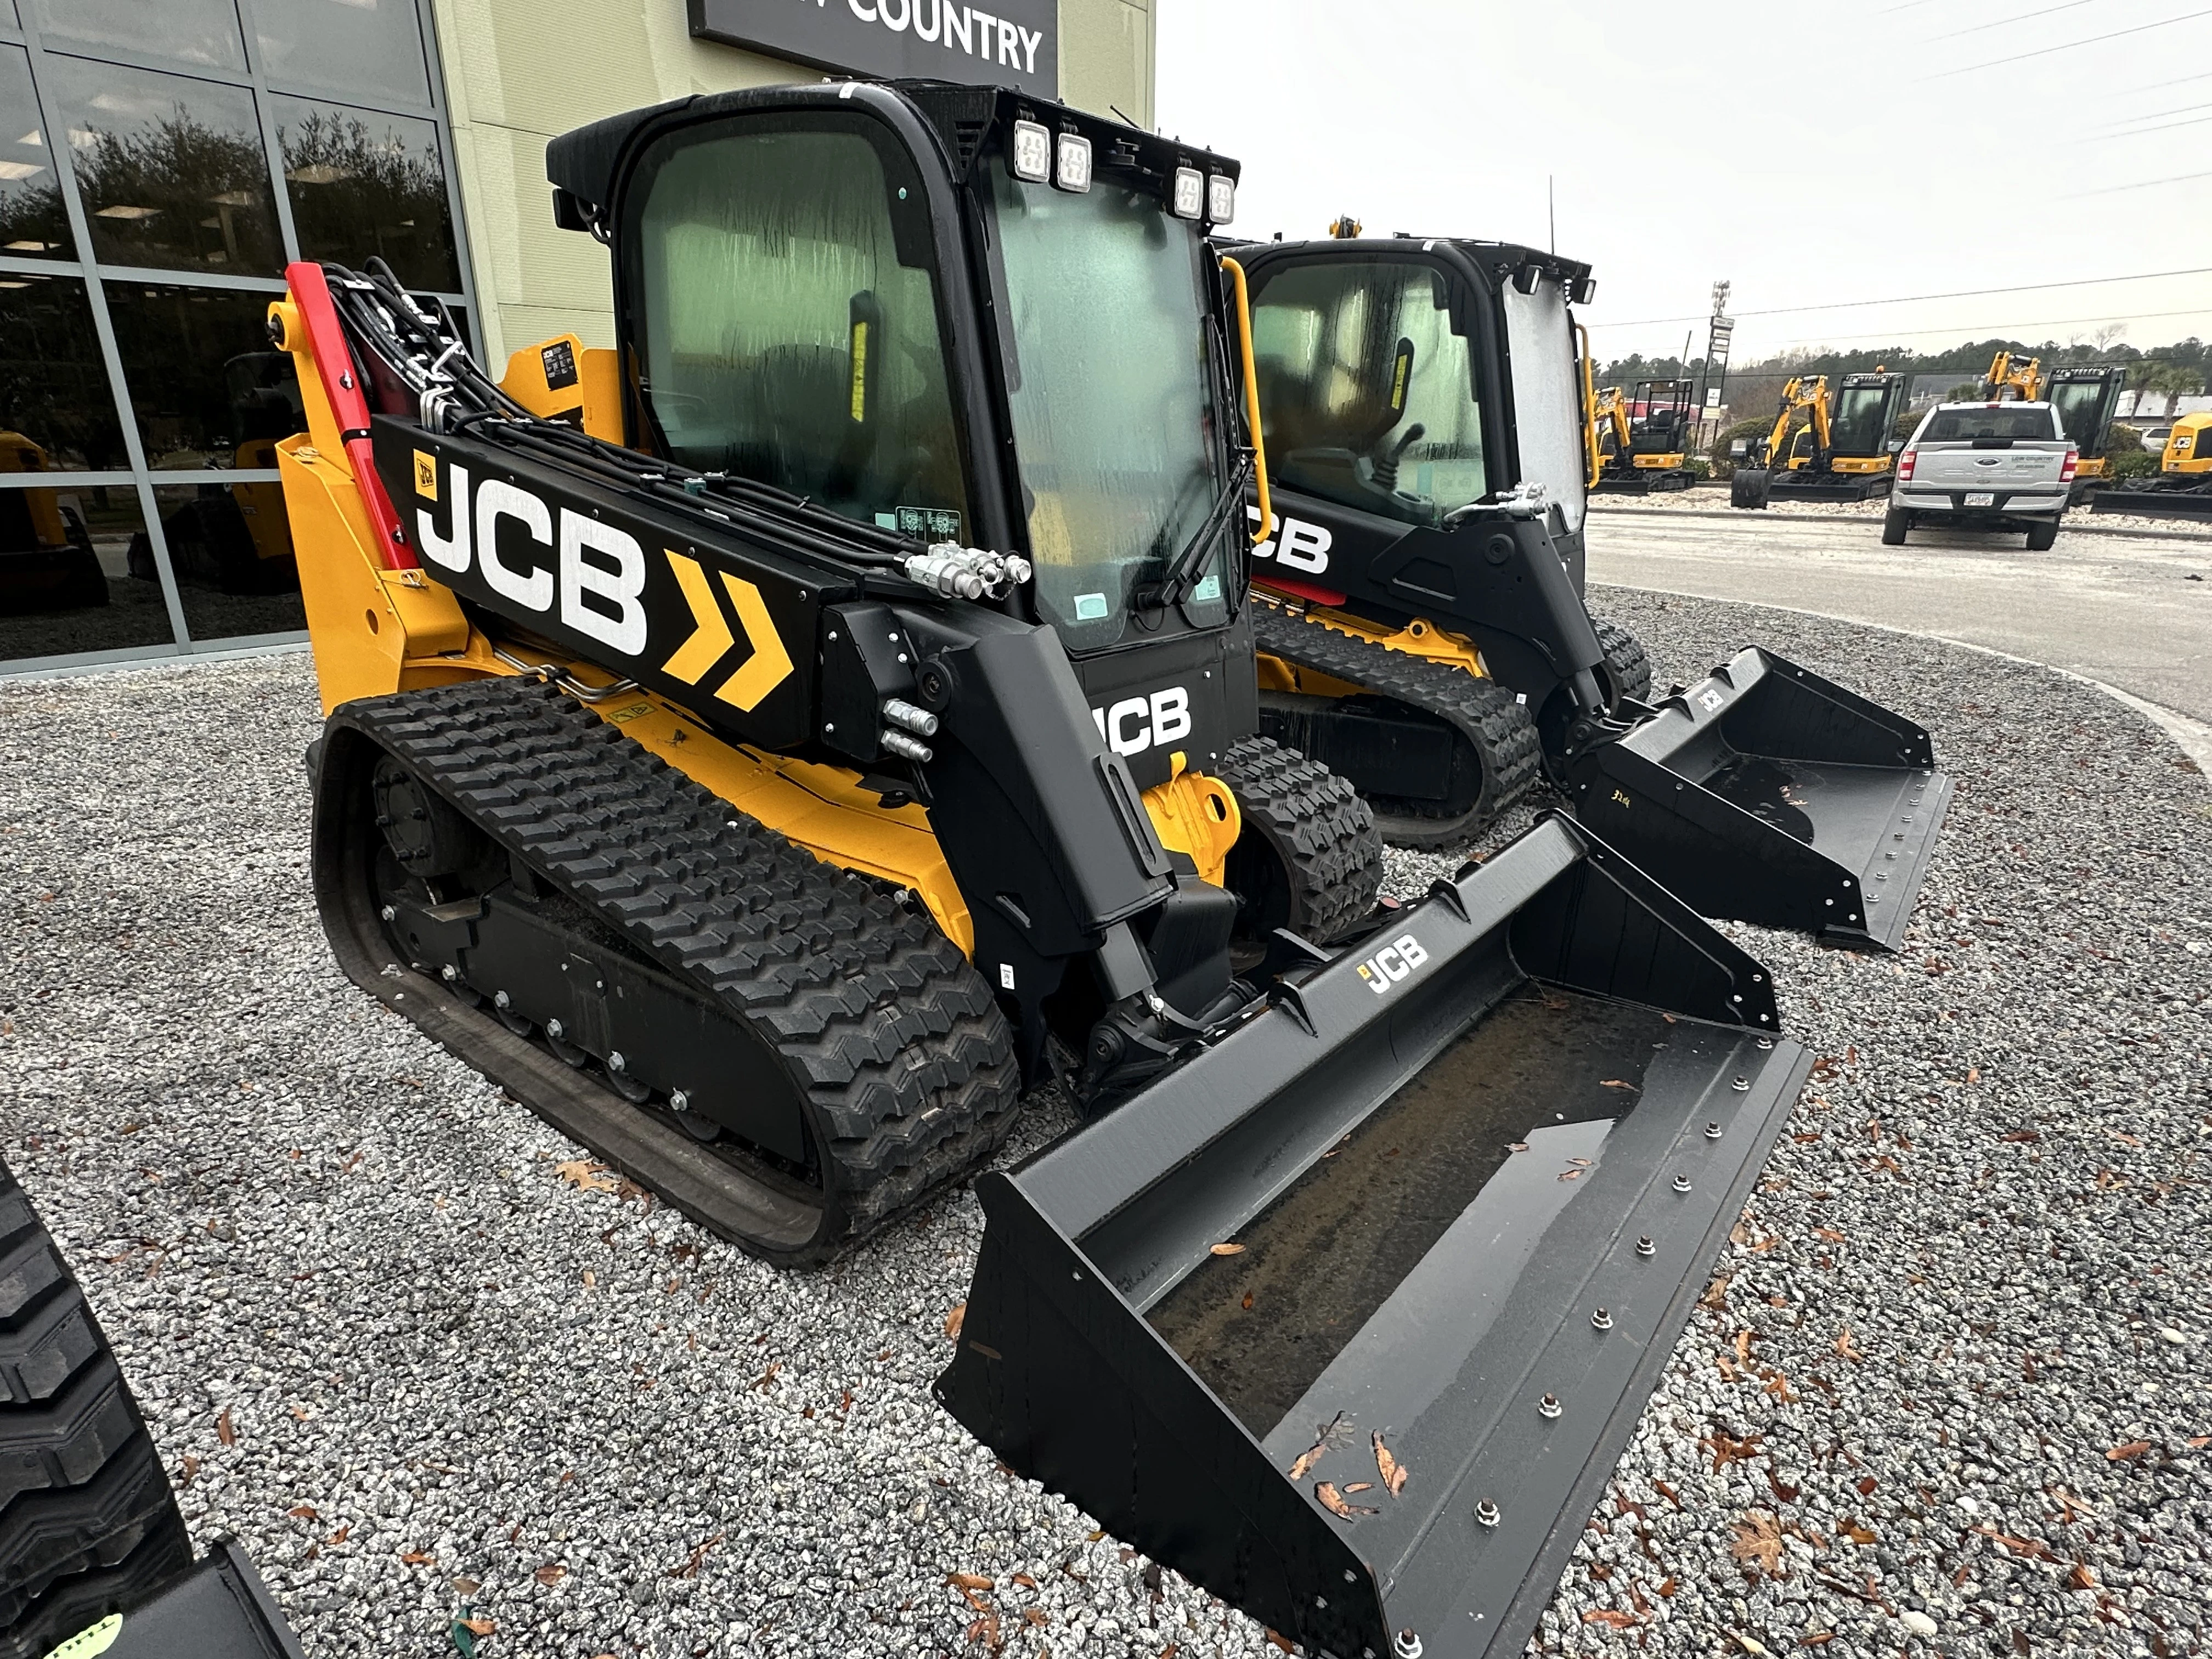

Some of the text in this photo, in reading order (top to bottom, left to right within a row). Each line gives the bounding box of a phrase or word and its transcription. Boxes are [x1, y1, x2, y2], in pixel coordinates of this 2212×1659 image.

[417, 463, 647, 656] JCB
[1700, 689, 1724, 712] JCB
[1366, 934, 1429, 994] JCB
